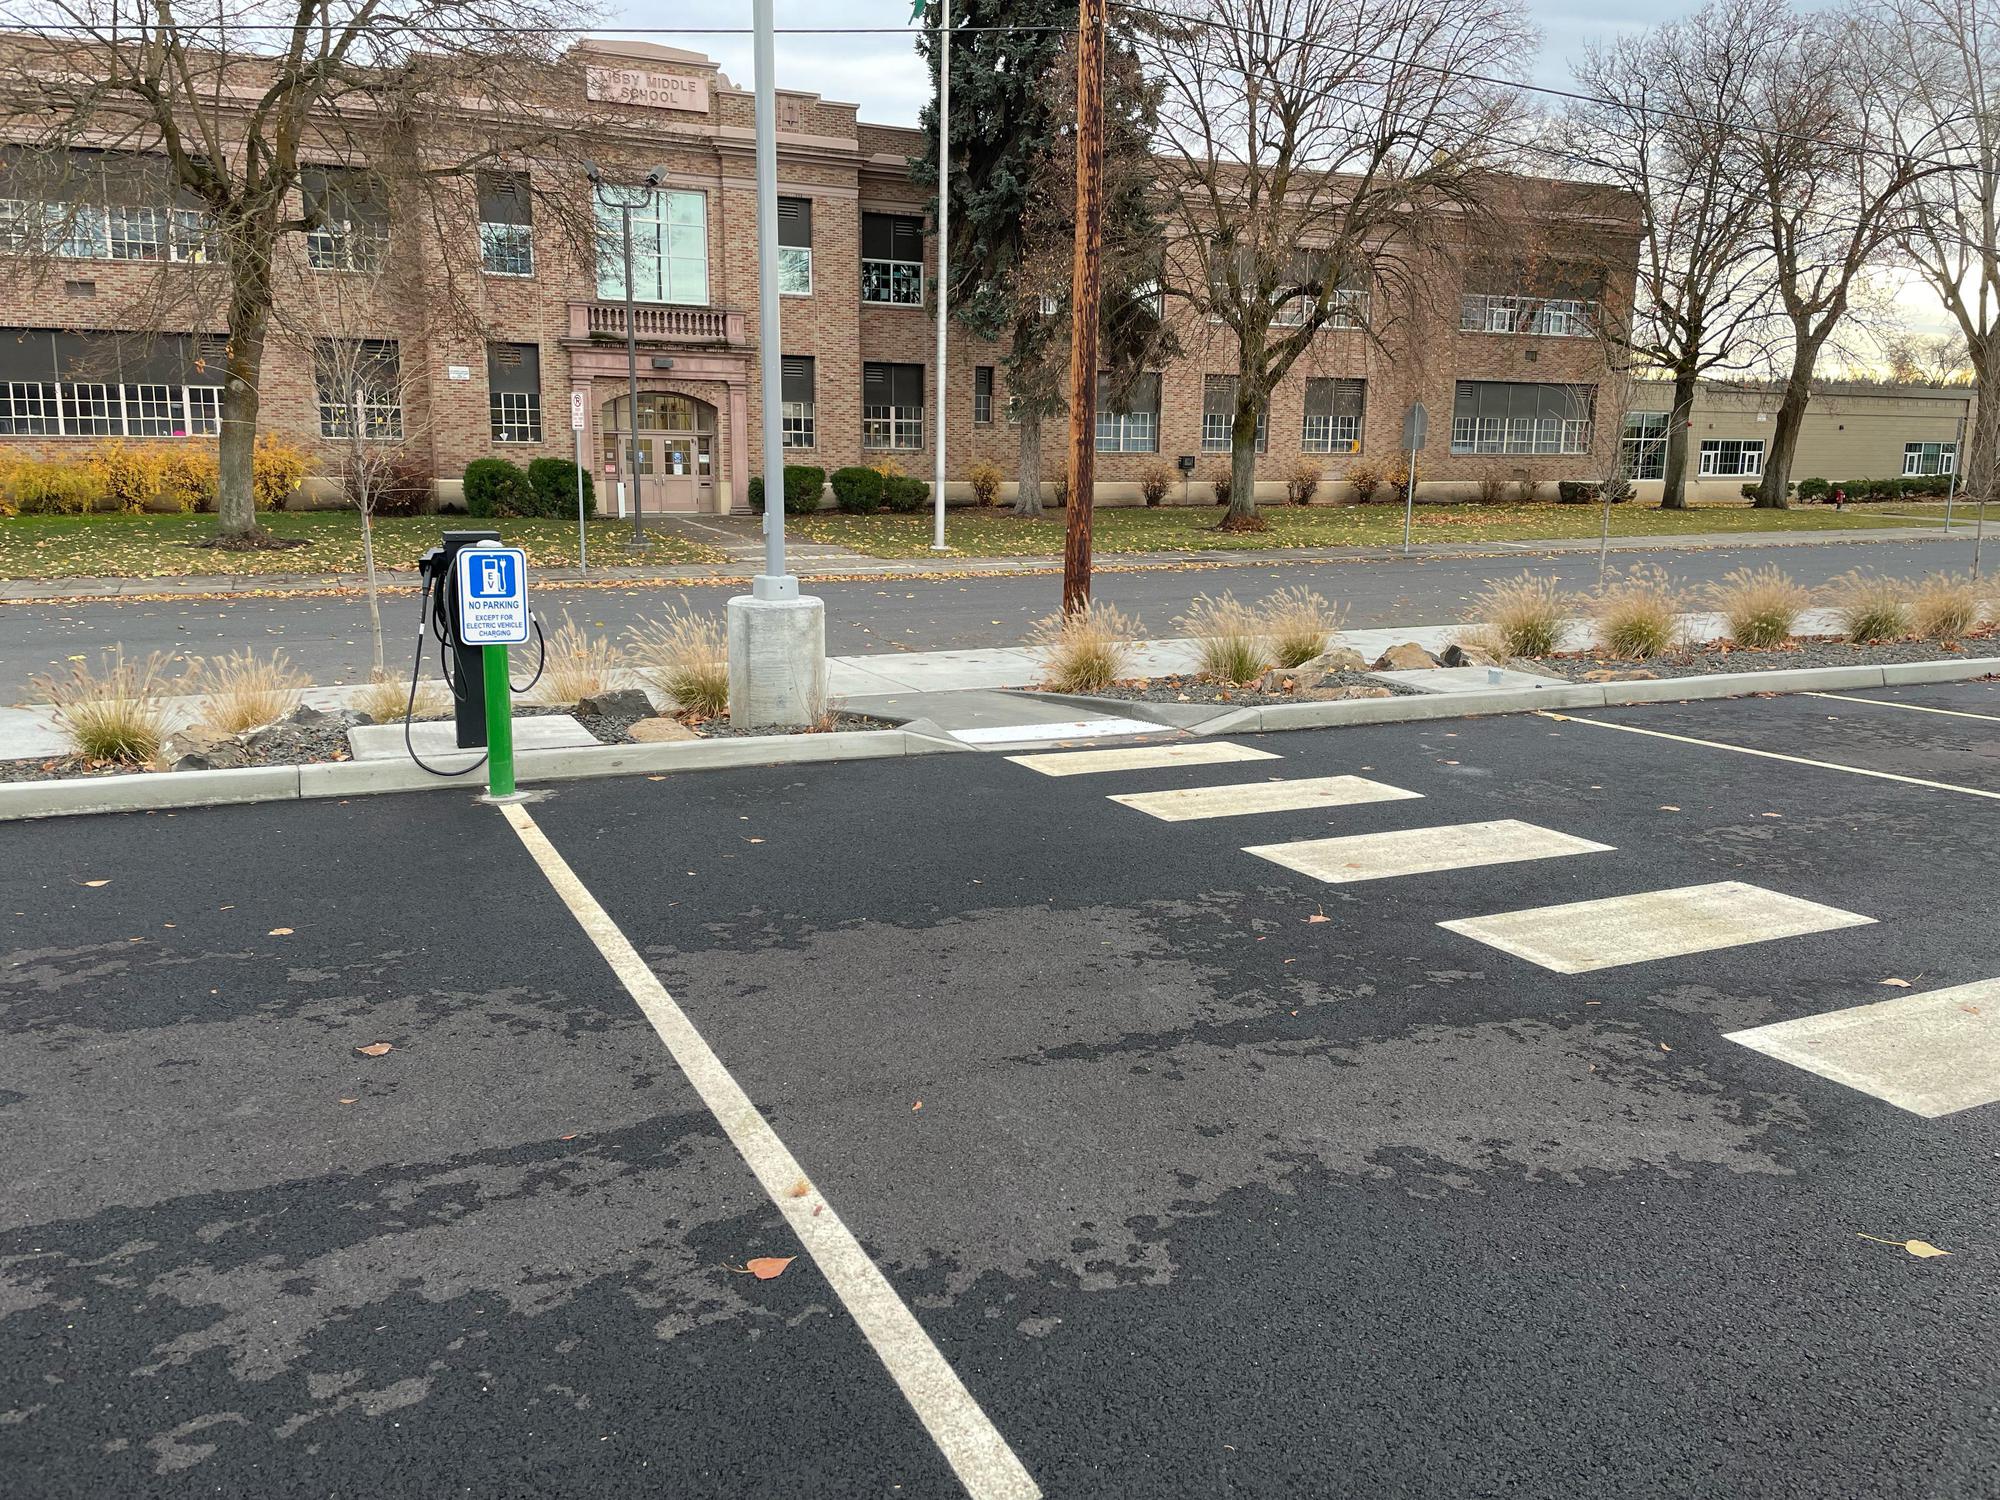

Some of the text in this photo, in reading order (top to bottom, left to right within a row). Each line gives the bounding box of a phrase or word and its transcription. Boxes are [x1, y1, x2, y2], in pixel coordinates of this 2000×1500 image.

[647, 76, 697, 93] MIDDLE
[620, 87, 679, 104] SCHOOL
[469, 600, 519, 610] NO PARKING
